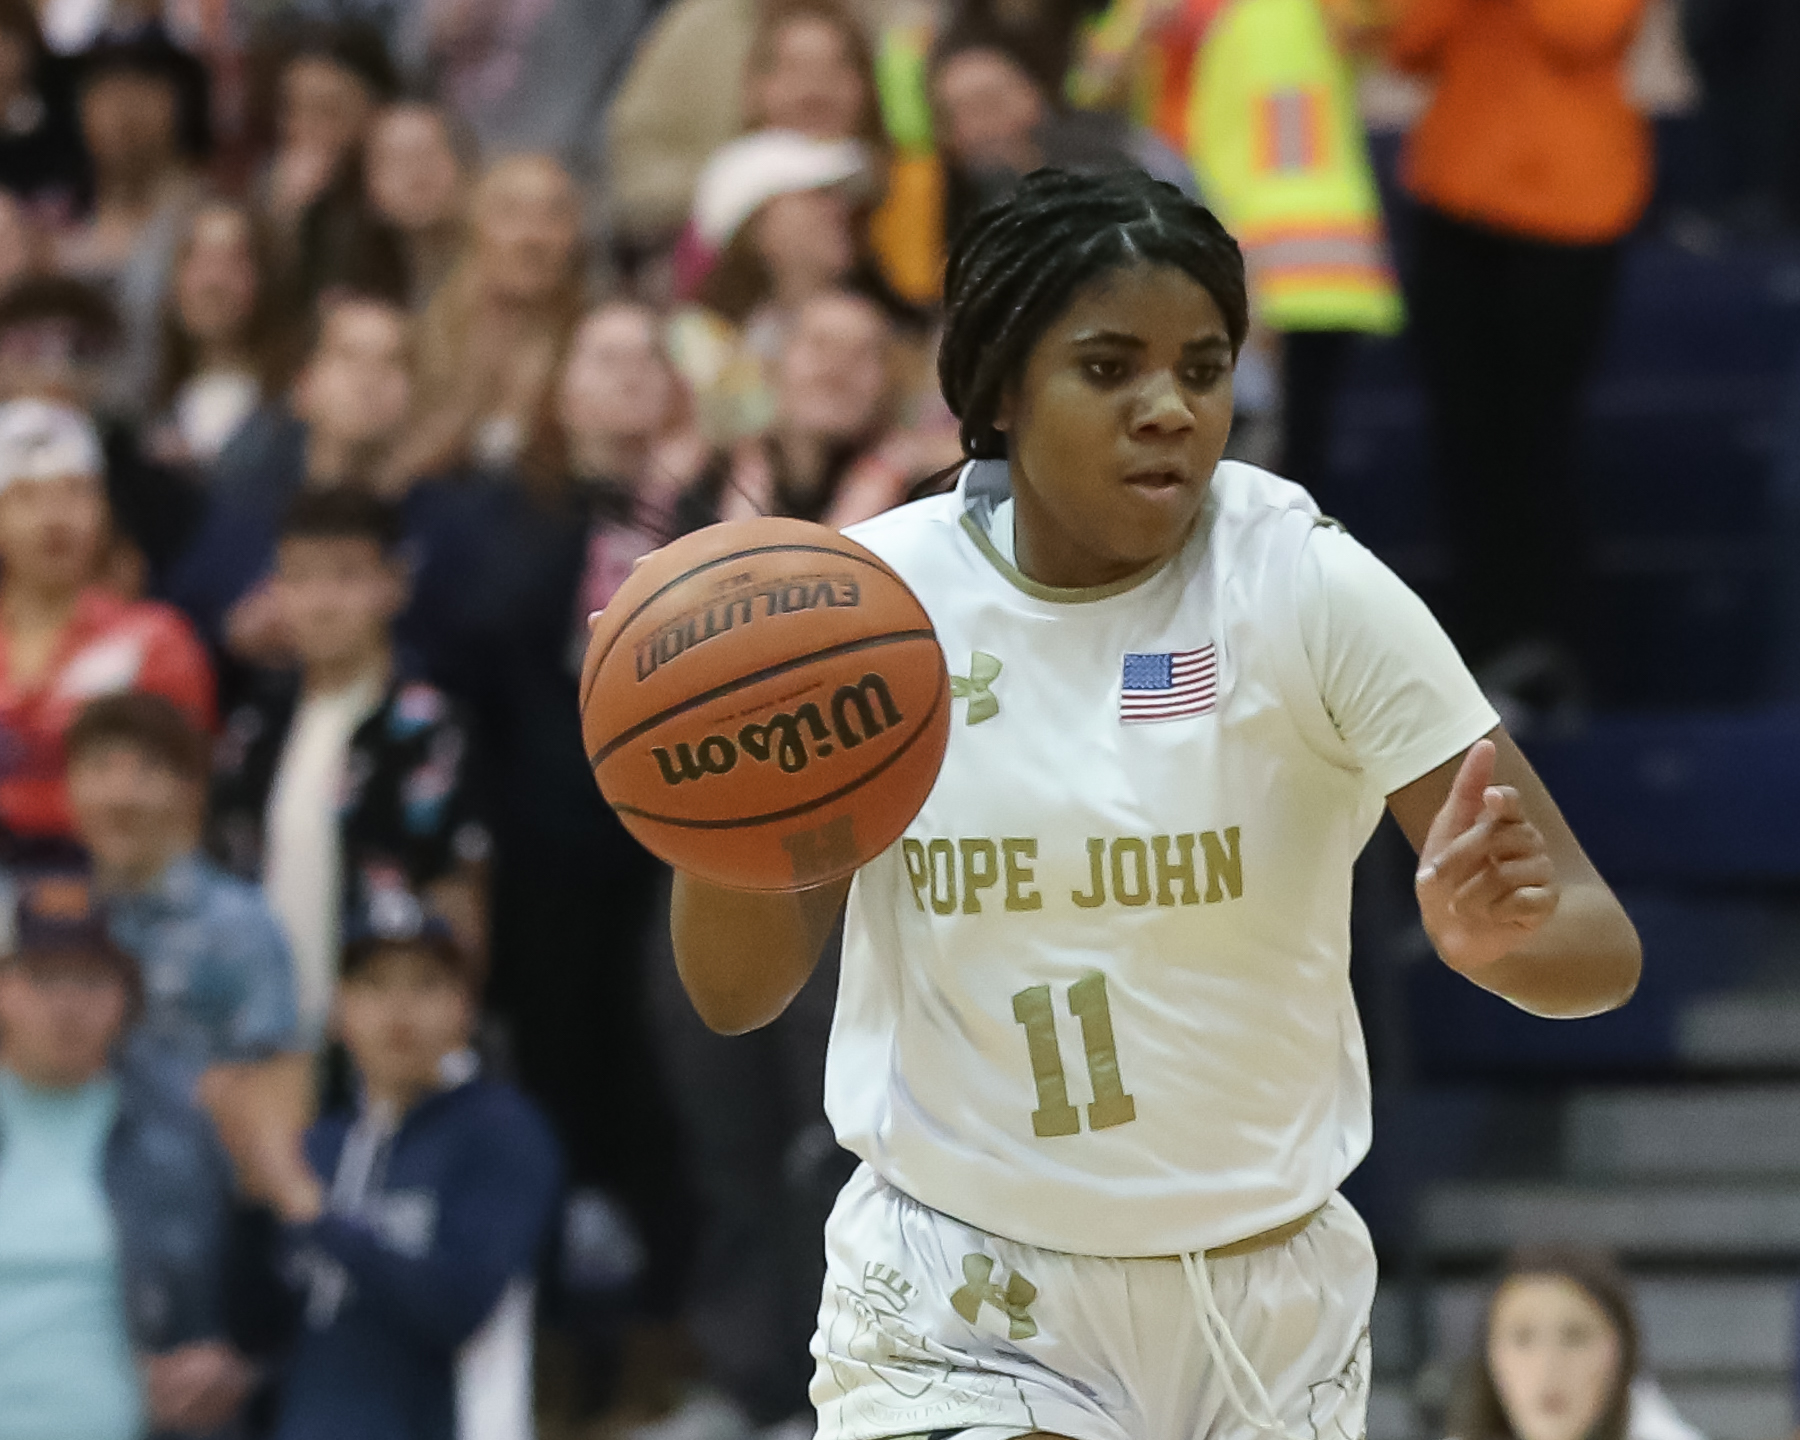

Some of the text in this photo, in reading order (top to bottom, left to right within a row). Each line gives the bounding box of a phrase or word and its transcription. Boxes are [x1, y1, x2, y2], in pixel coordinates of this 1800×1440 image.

[634, 576, 861, 682] EVOLUTION
[651, 672, 903, 785] Wilson
[902, 827, 1243, 915] POPE JOHN
[1012, 969, 1136, 1137] 11
